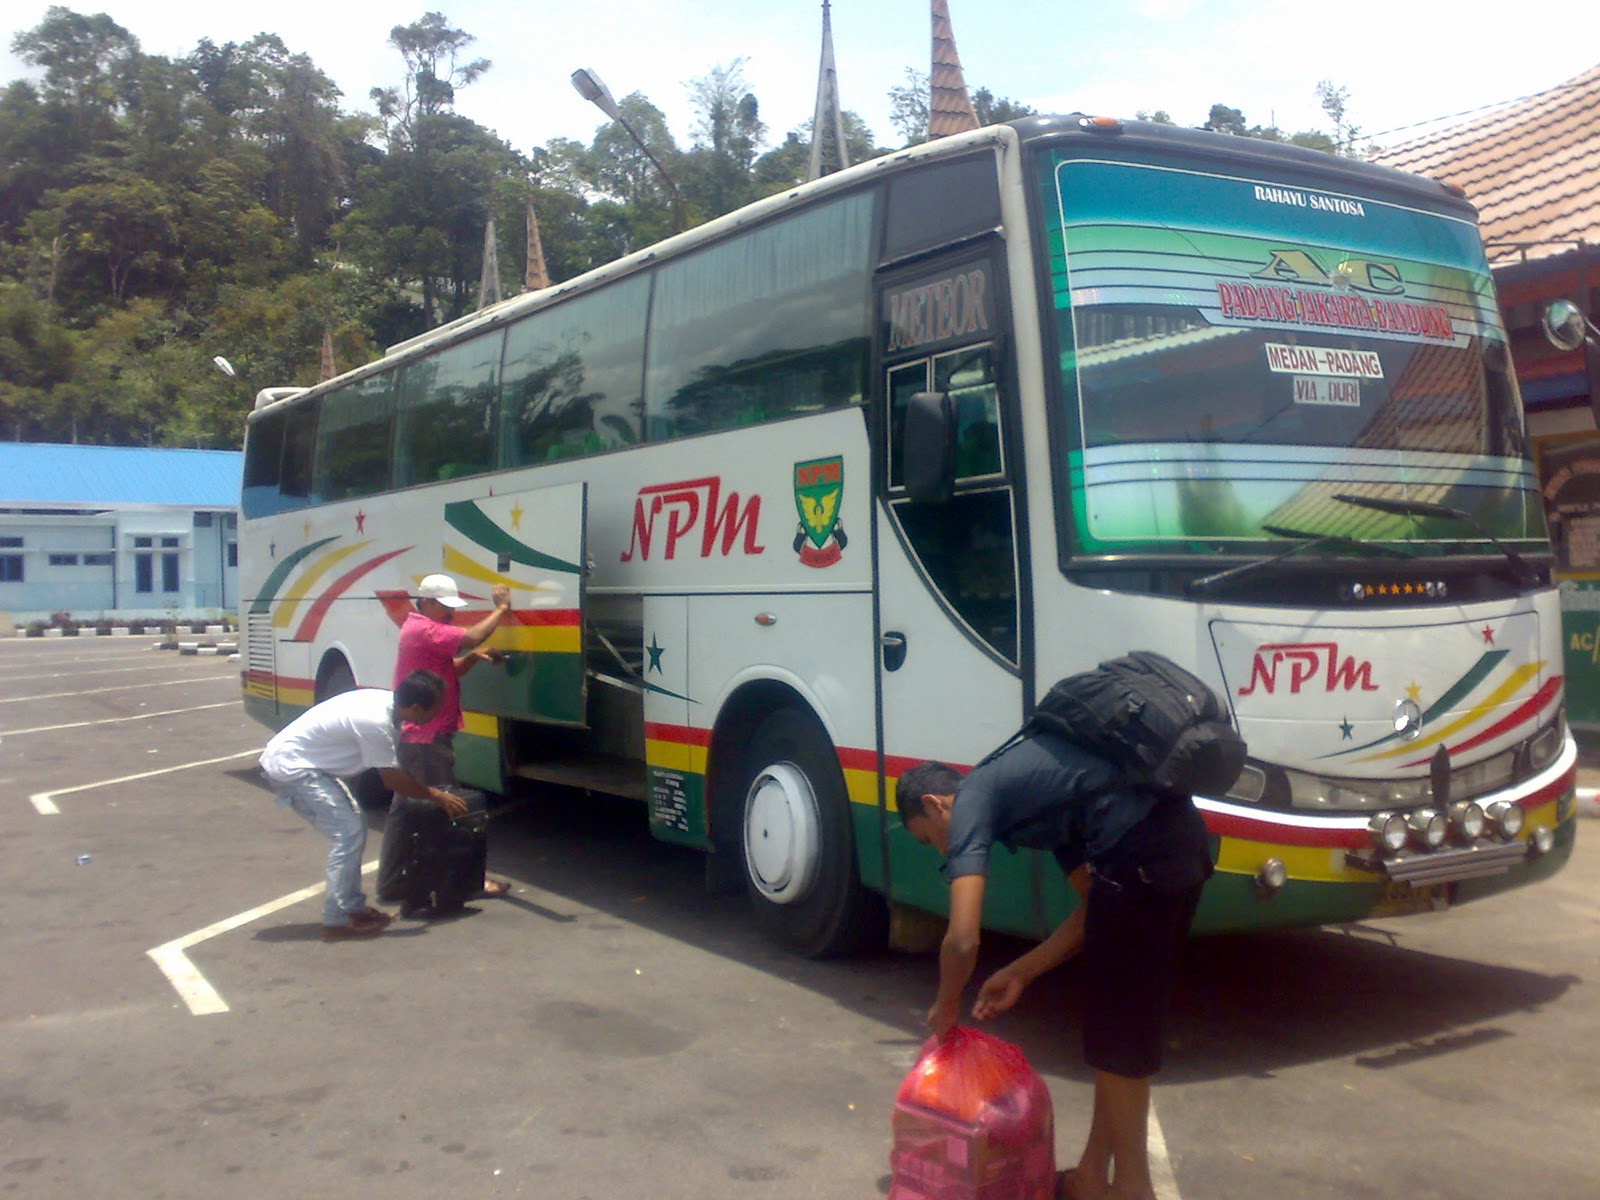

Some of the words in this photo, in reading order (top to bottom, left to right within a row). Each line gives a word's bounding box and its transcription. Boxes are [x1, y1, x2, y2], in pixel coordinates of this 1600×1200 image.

[1254, 185, 1307, 207] RAHAYU
[1309, 195, 1365, 217] SANTOSA
[888, 270, 988, 352] METEOR
[1328, 381, 1359, 403] DURI
[797, 461, 842, 487] NPM
[620, 476, 765, 562] NPM
[1238, 642, 1379, 697] NPM
